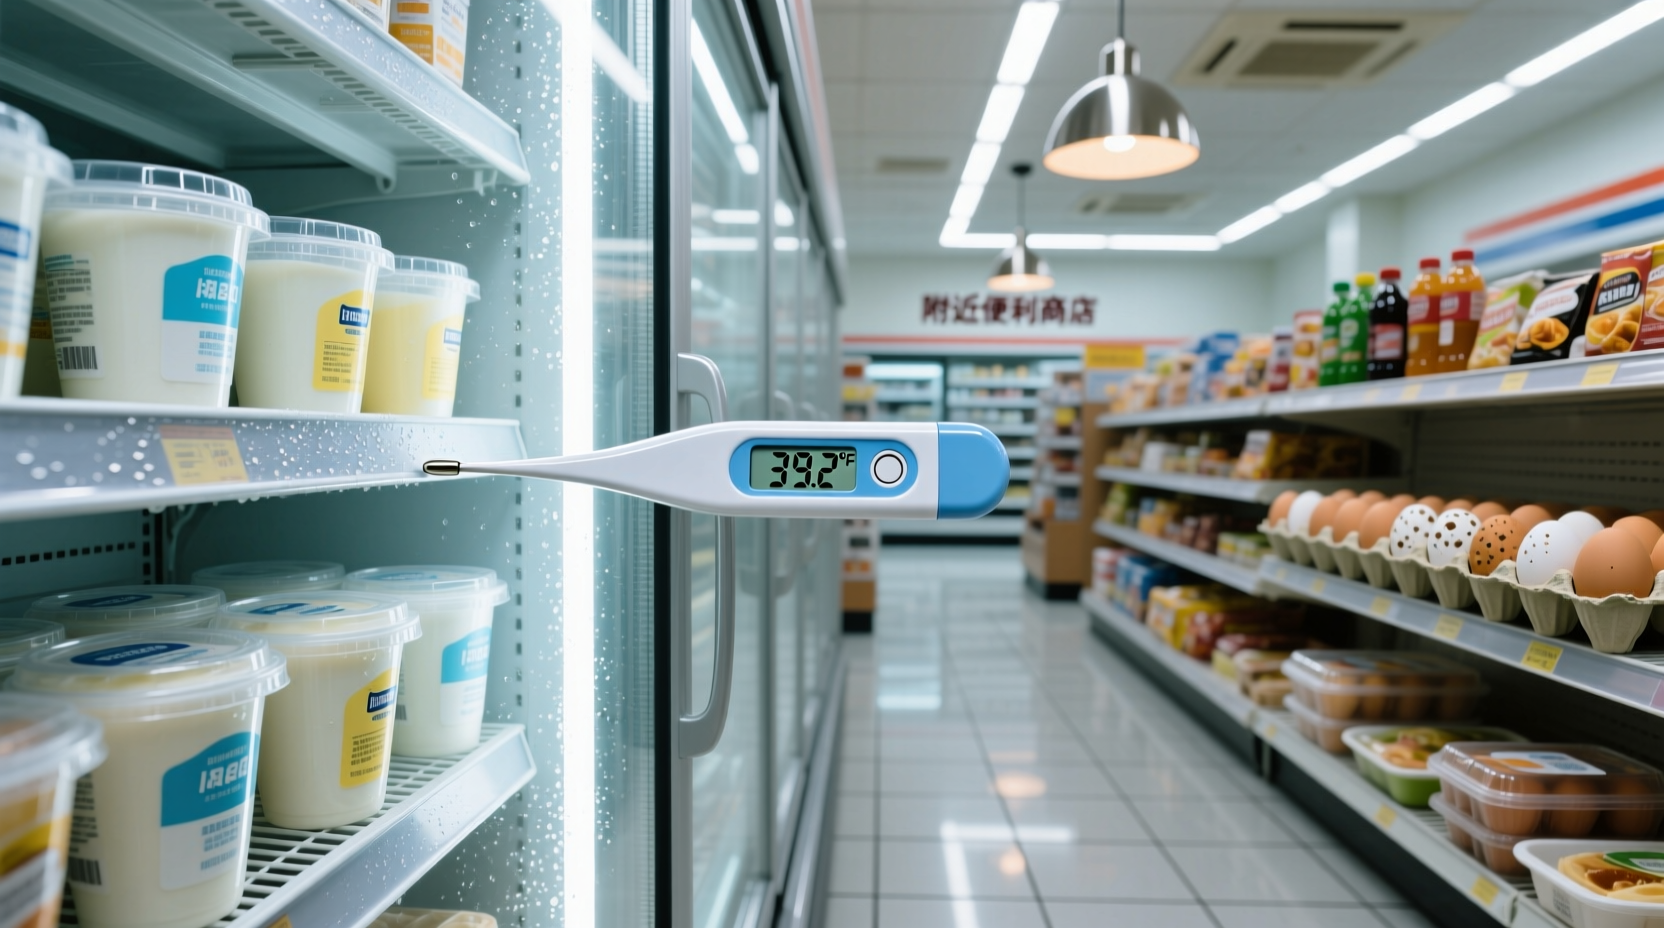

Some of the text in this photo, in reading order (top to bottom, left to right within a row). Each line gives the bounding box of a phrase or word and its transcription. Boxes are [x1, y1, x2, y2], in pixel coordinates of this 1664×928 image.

[922, 293, 1097, 325] 附近便利商店
